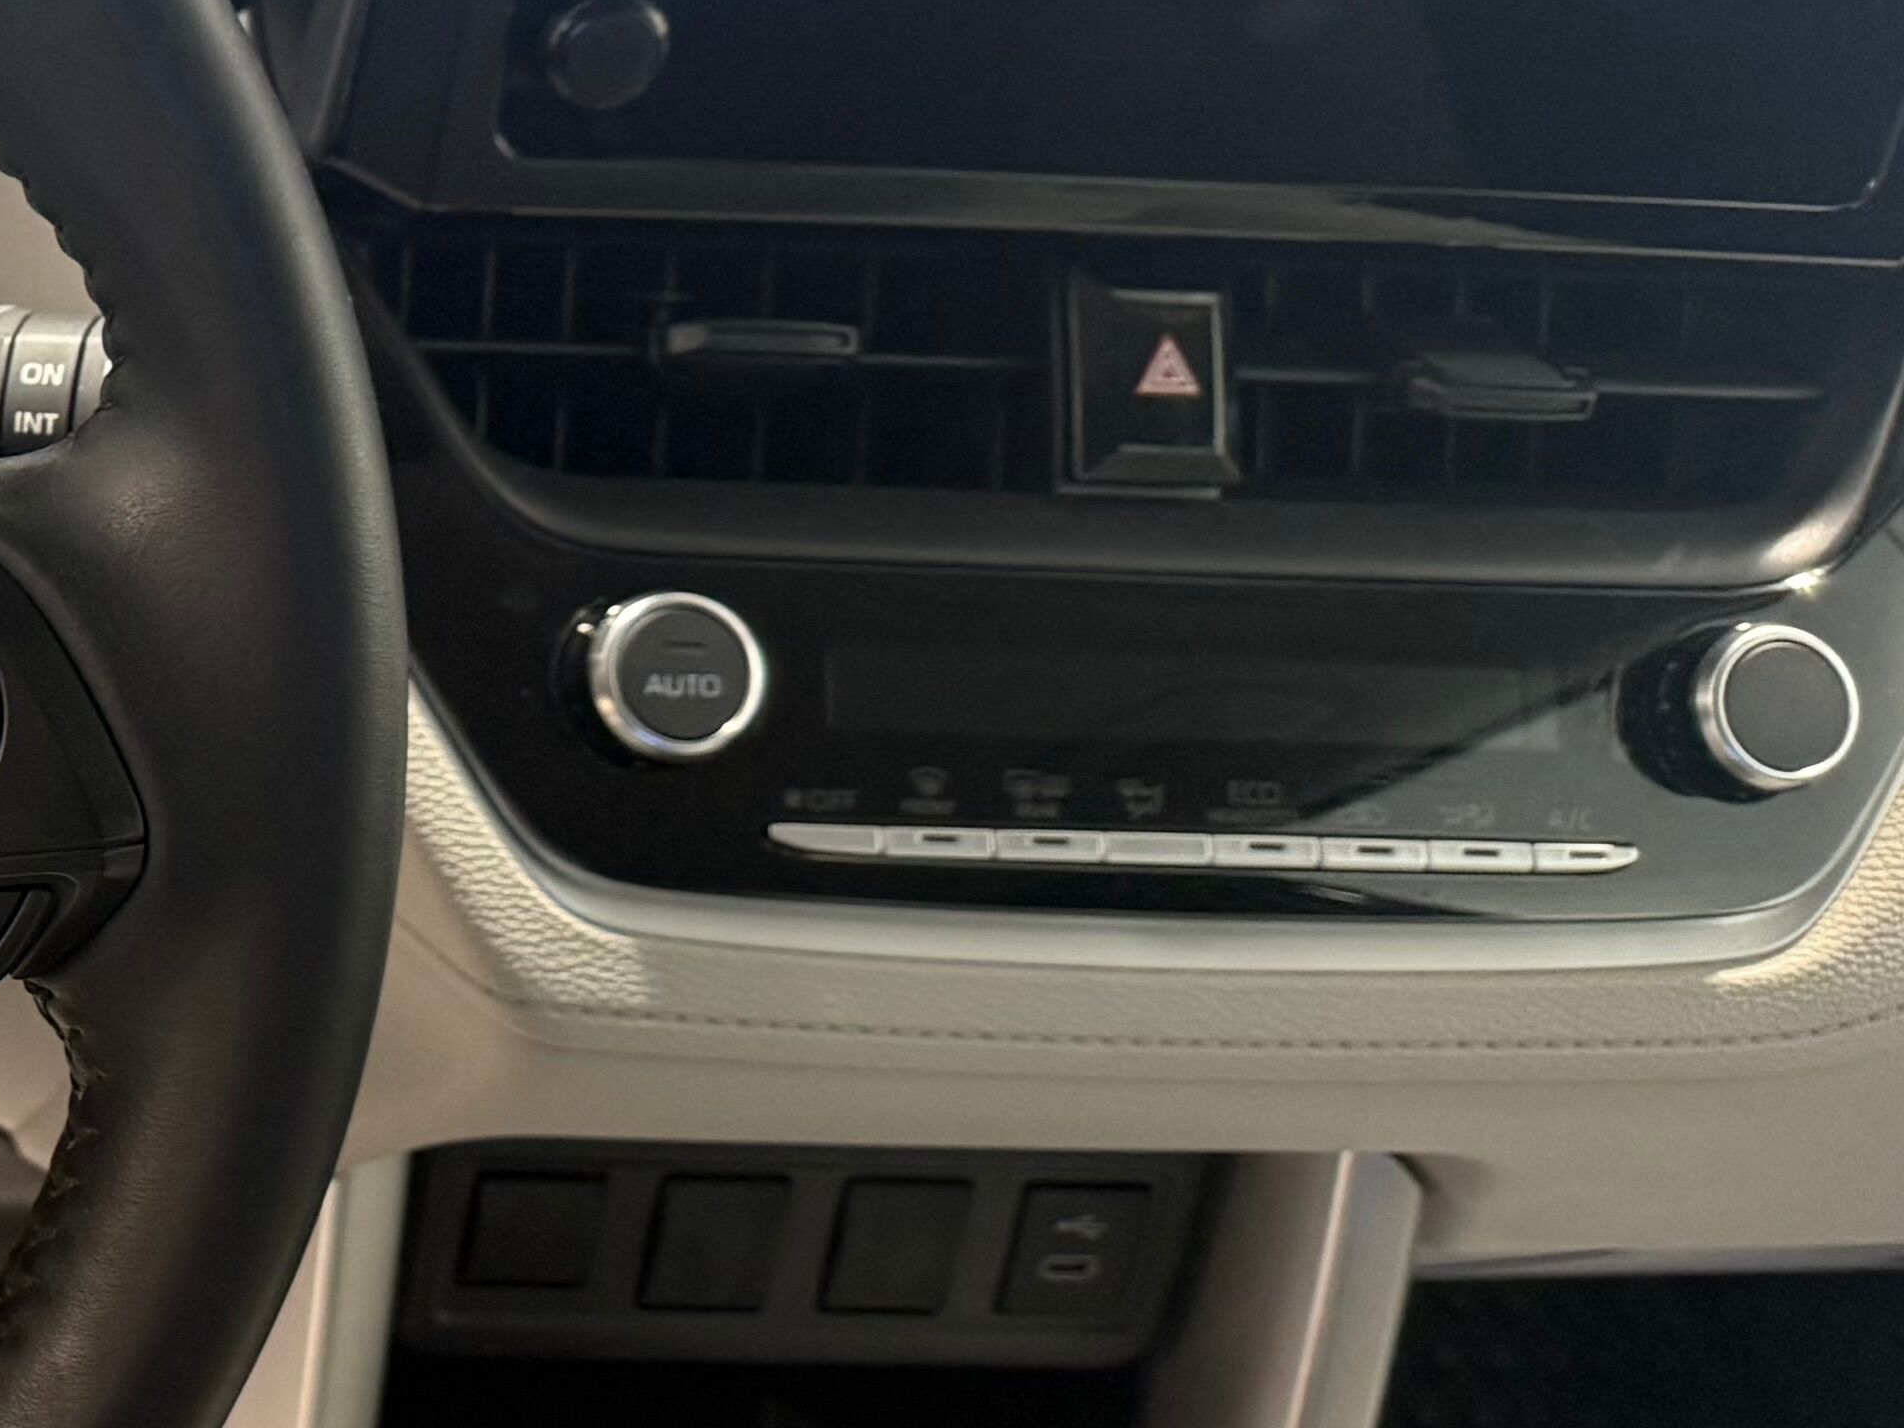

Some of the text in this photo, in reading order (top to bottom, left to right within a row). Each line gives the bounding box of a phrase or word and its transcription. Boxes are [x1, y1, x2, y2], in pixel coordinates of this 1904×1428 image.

[19, 362, 66, 386] ON
[13, 410, 59, 436] INT
[642, 672, 723, 699] AUTO
